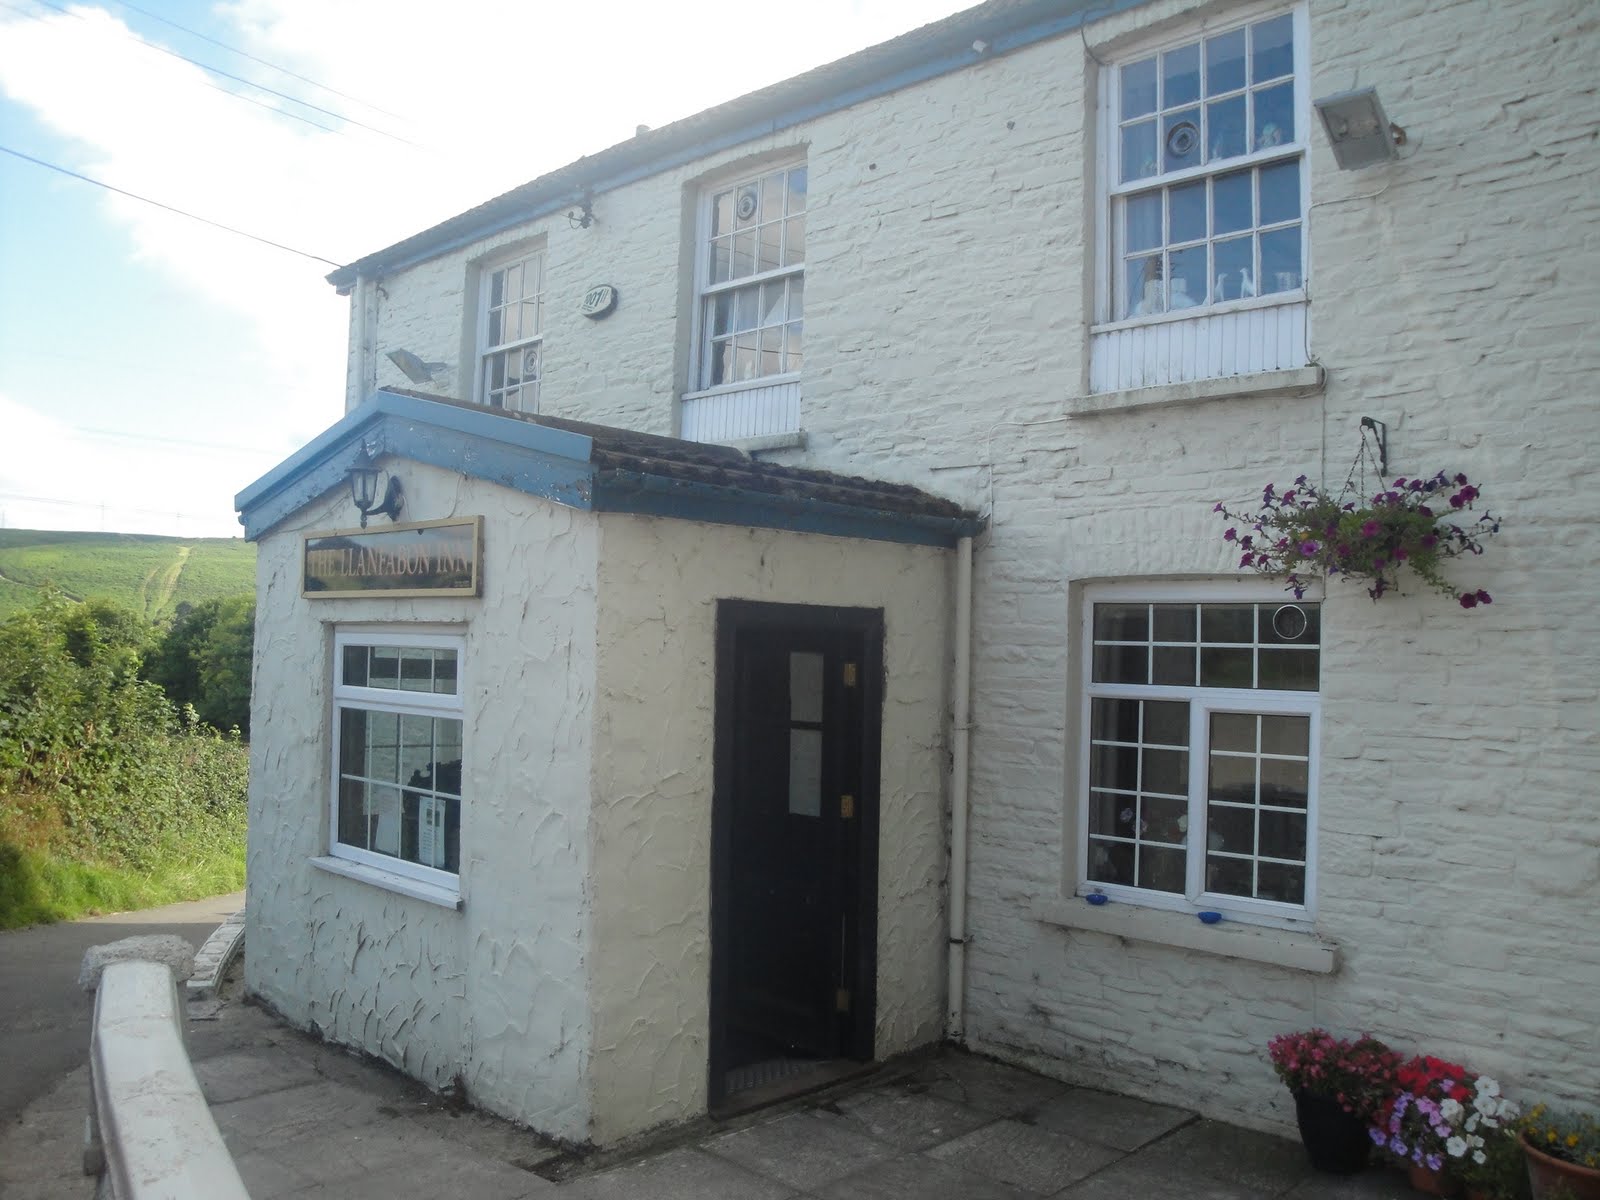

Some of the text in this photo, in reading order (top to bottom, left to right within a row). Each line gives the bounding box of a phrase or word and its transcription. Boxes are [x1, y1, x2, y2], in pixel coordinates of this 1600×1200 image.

[308, 543, 469, 577] THE LLANFABON INN
